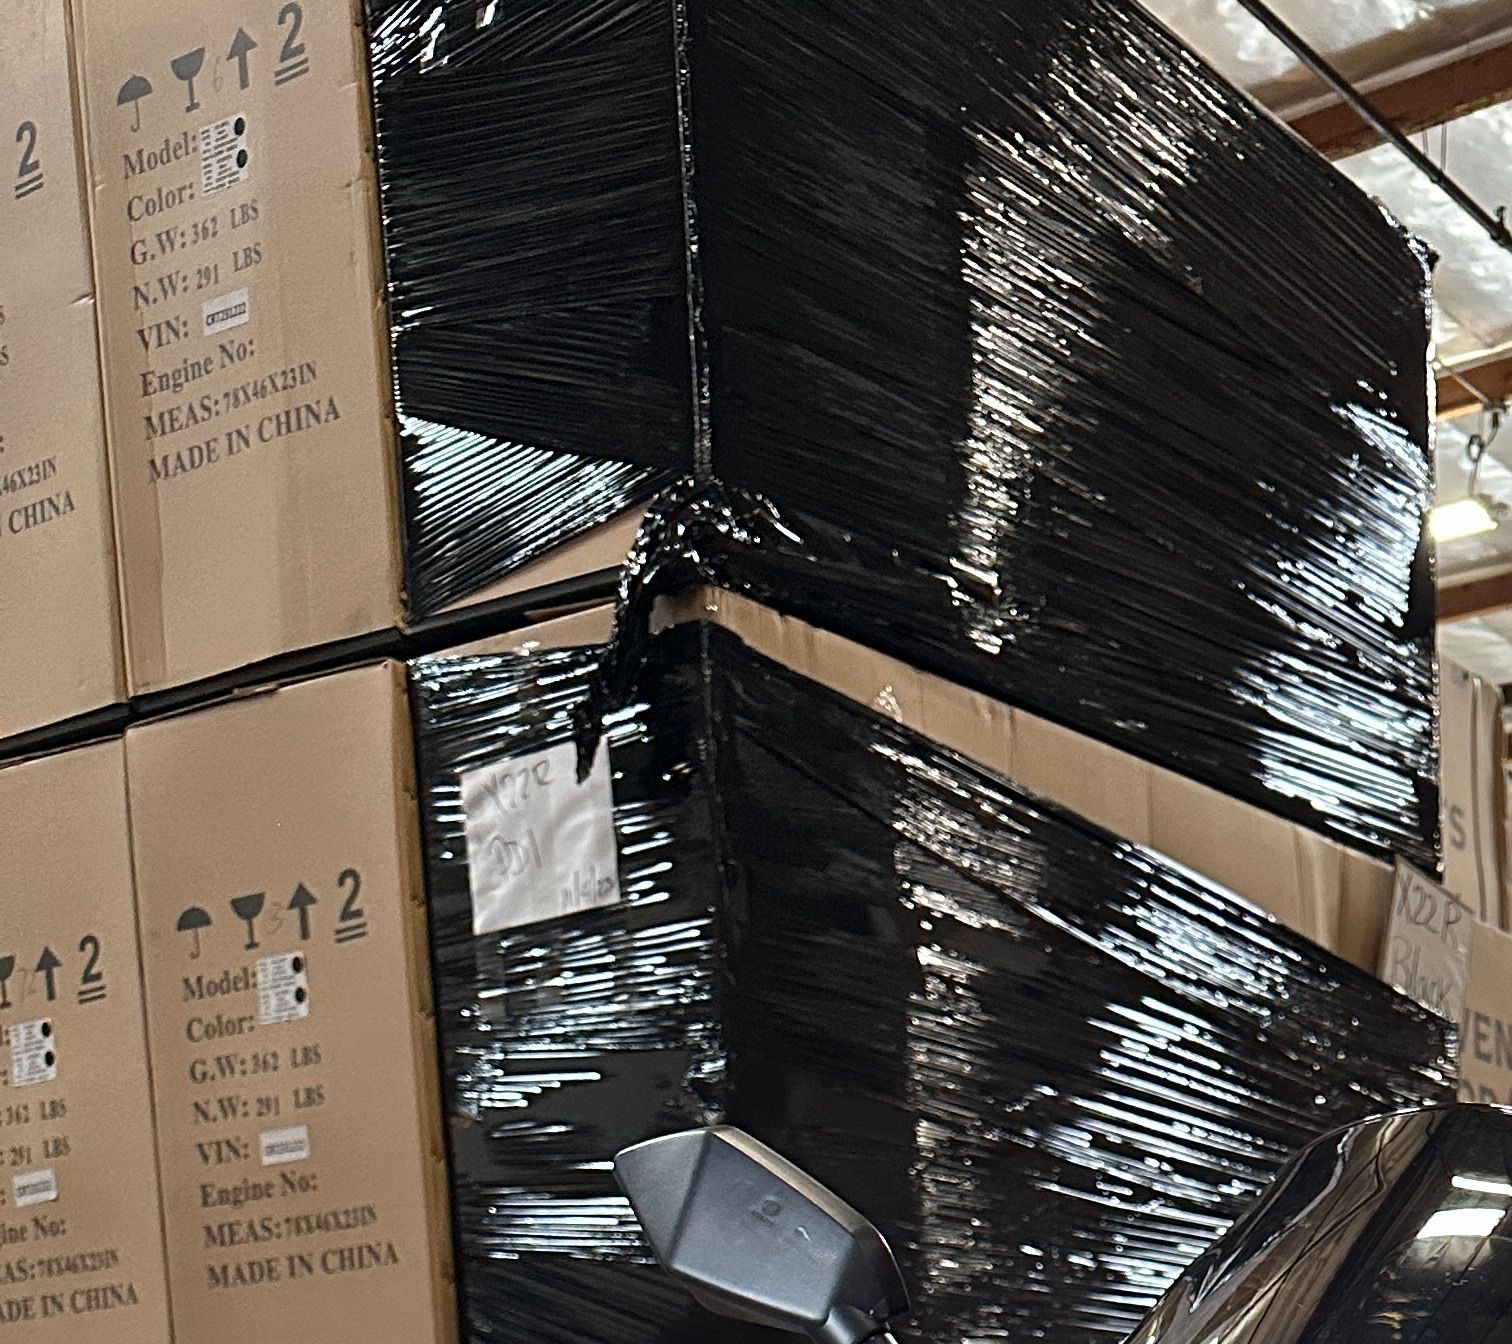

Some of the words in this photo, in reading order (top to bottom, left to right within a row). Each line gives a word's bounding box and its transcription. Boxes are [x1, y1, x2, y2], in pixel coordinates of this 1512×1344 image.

[278, 2, 305, 63] 2
[16, 120, 39, 177] 2
[123, 132, 198, 180] Model:
[127, 182, 194, 222] Color:
[229, 198, 259, 229] LBS
[196, 264, 219, 290] 291
[232, 242, 262, 272] LBS
[136, 314, 189, 353] VIN:
[140, 356, 213, 398] Engine
[219, 339, 254, 368] No:
[147, 437, 220, 484] MADE
[225, 425, 250, 457] IN
[257, 396, 340, 444] CHINA
[8, 489, 75, 534] CHINA
[336, 868, 364, 922] 2
[79, 935, 103, 984] 2
[182, 966, 258, 1001] Model:
[186, 1014, 255, 1043] Color:
[196, 1137, 249, 1166] VIN:
[200, 1178, 274, 1211] Engine
[280, 1169, 318, 1197] No:
[31, 1215, 67, 1242] No:
[207, 1256, 280, 1289] MADE
[287, 1253, 314, 1280] IN
[320, 1240, 399, 1275] CHINA
[41, 1292, 64, 1318] IN
[69, 1282, 139, 1315] CHINA
